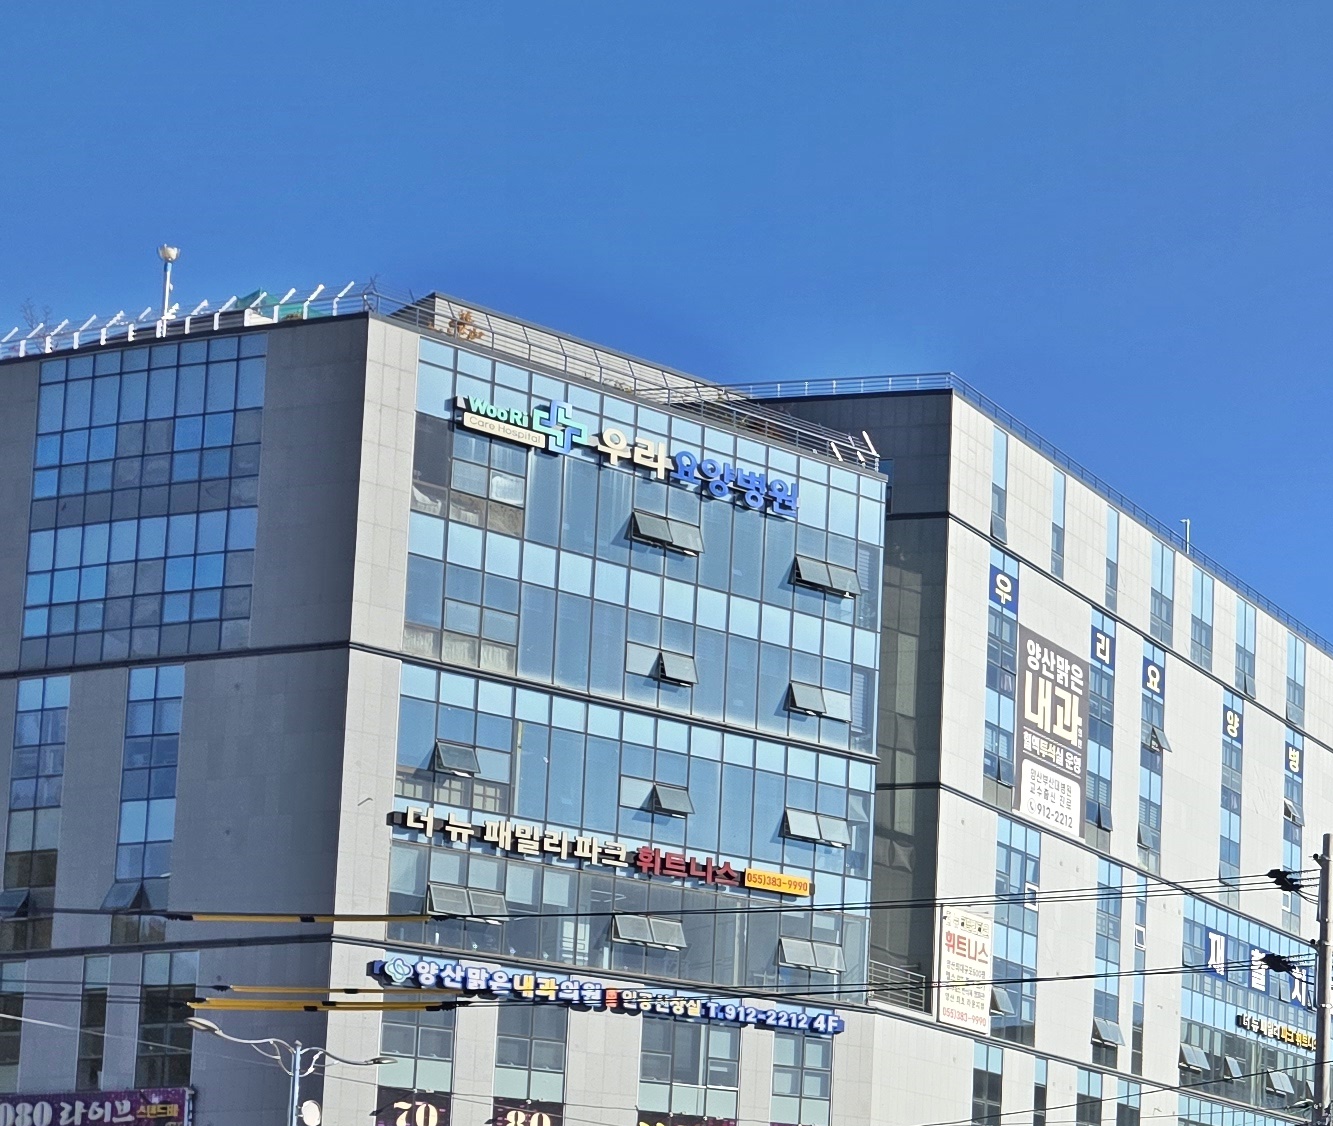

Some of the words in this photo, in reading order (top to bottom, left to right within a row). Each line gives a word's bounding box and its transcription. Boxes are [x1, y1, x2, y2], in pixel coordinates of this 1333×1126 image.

[469, 414, 495, 432] Care
[497, 421, 542, 445] Hospital
[1026, 639, 1083, 696] 양산맑은
[1024, 670, 1083, 748] 내과
[1036, 802, 1074, 830] 912-2212
[406, 805, 435, 838] 더
[445, 812, 475, 844] 뉴
[636, 845, 741, 888] 휘트니스
[746, 869, 809, 893] 055)383-9990
[944, 930, 989, 965] 휘트니스
[812, 1013, 839, 1034] 4F
[59, 1099, 135, 1126] 라이브
